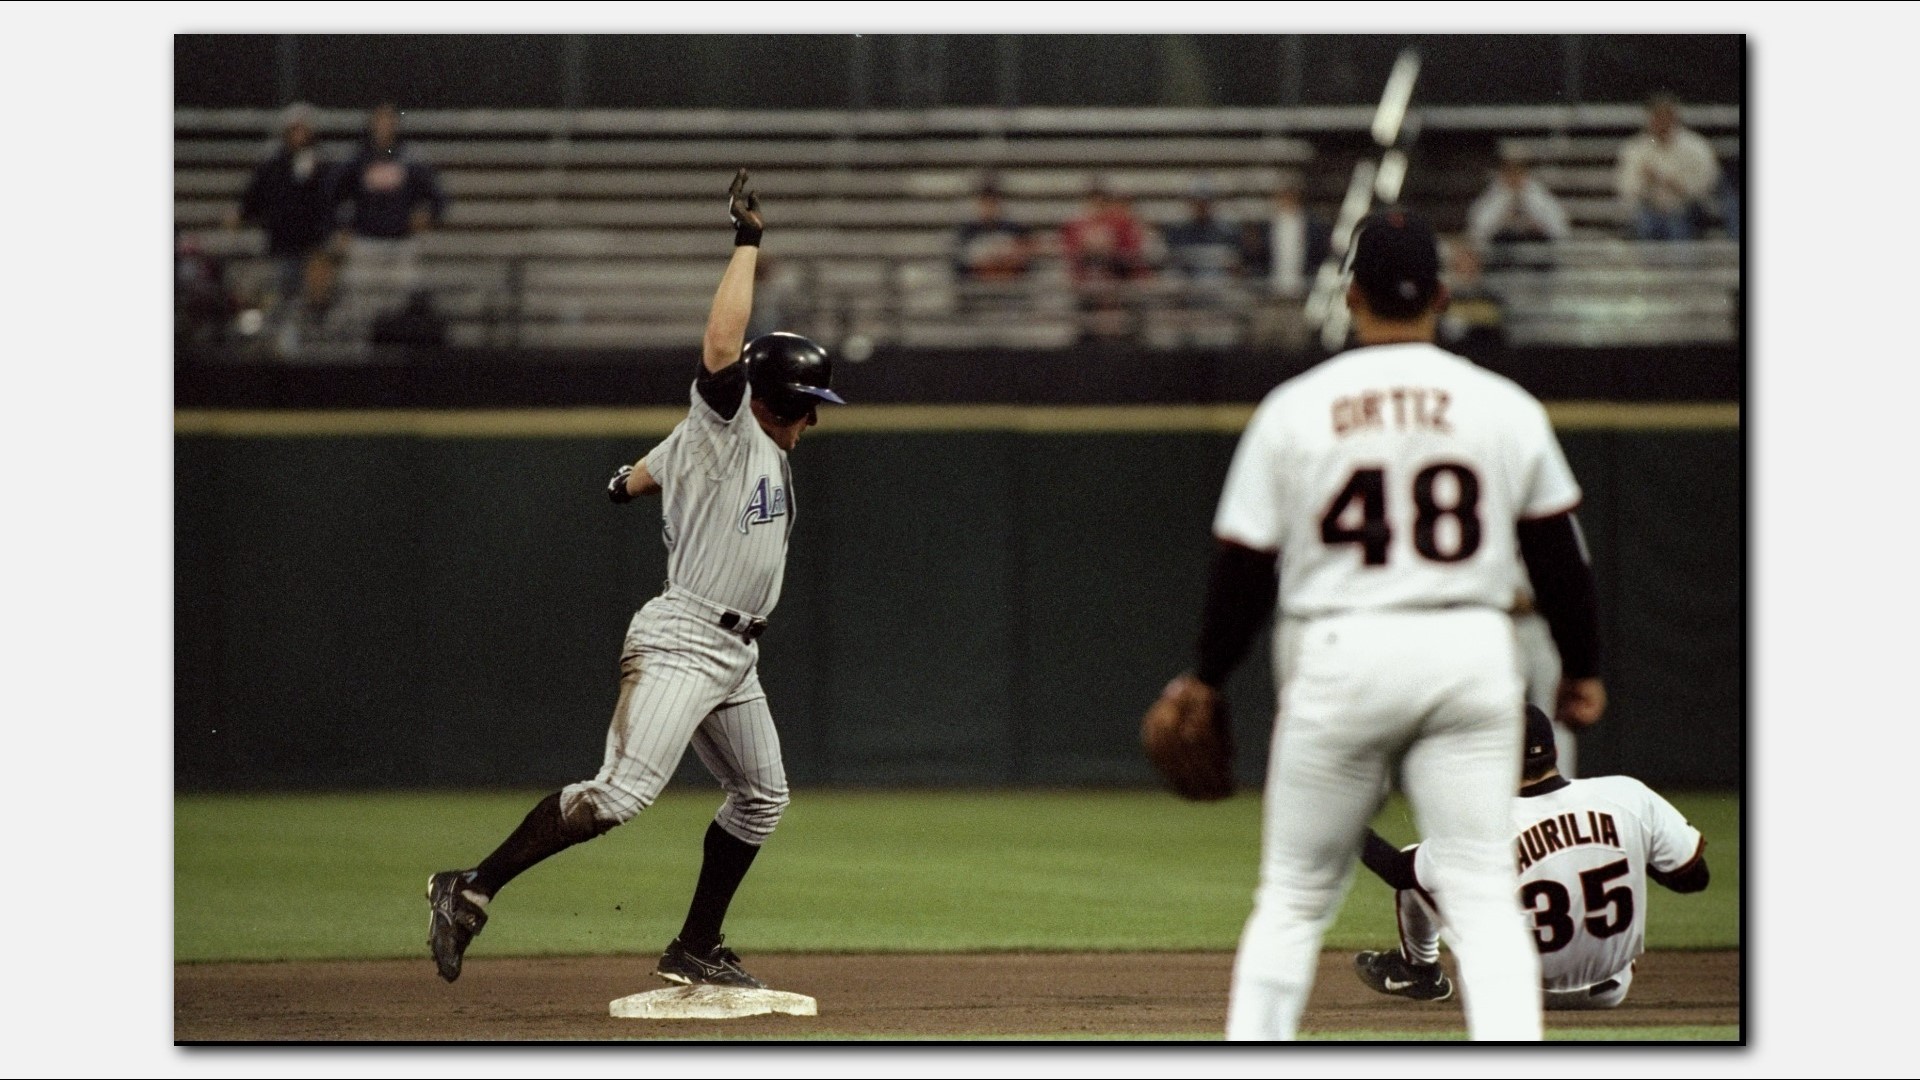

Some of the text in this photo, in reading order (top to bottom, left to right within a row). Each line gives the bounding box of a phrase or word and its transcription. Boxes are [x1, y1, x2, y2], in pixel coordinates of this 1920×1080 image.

[1331, 388, 1453, 437] ORTIZ
[1319, 462, 1484, 567] 48
[1519, 857, 1634, 955] 35
